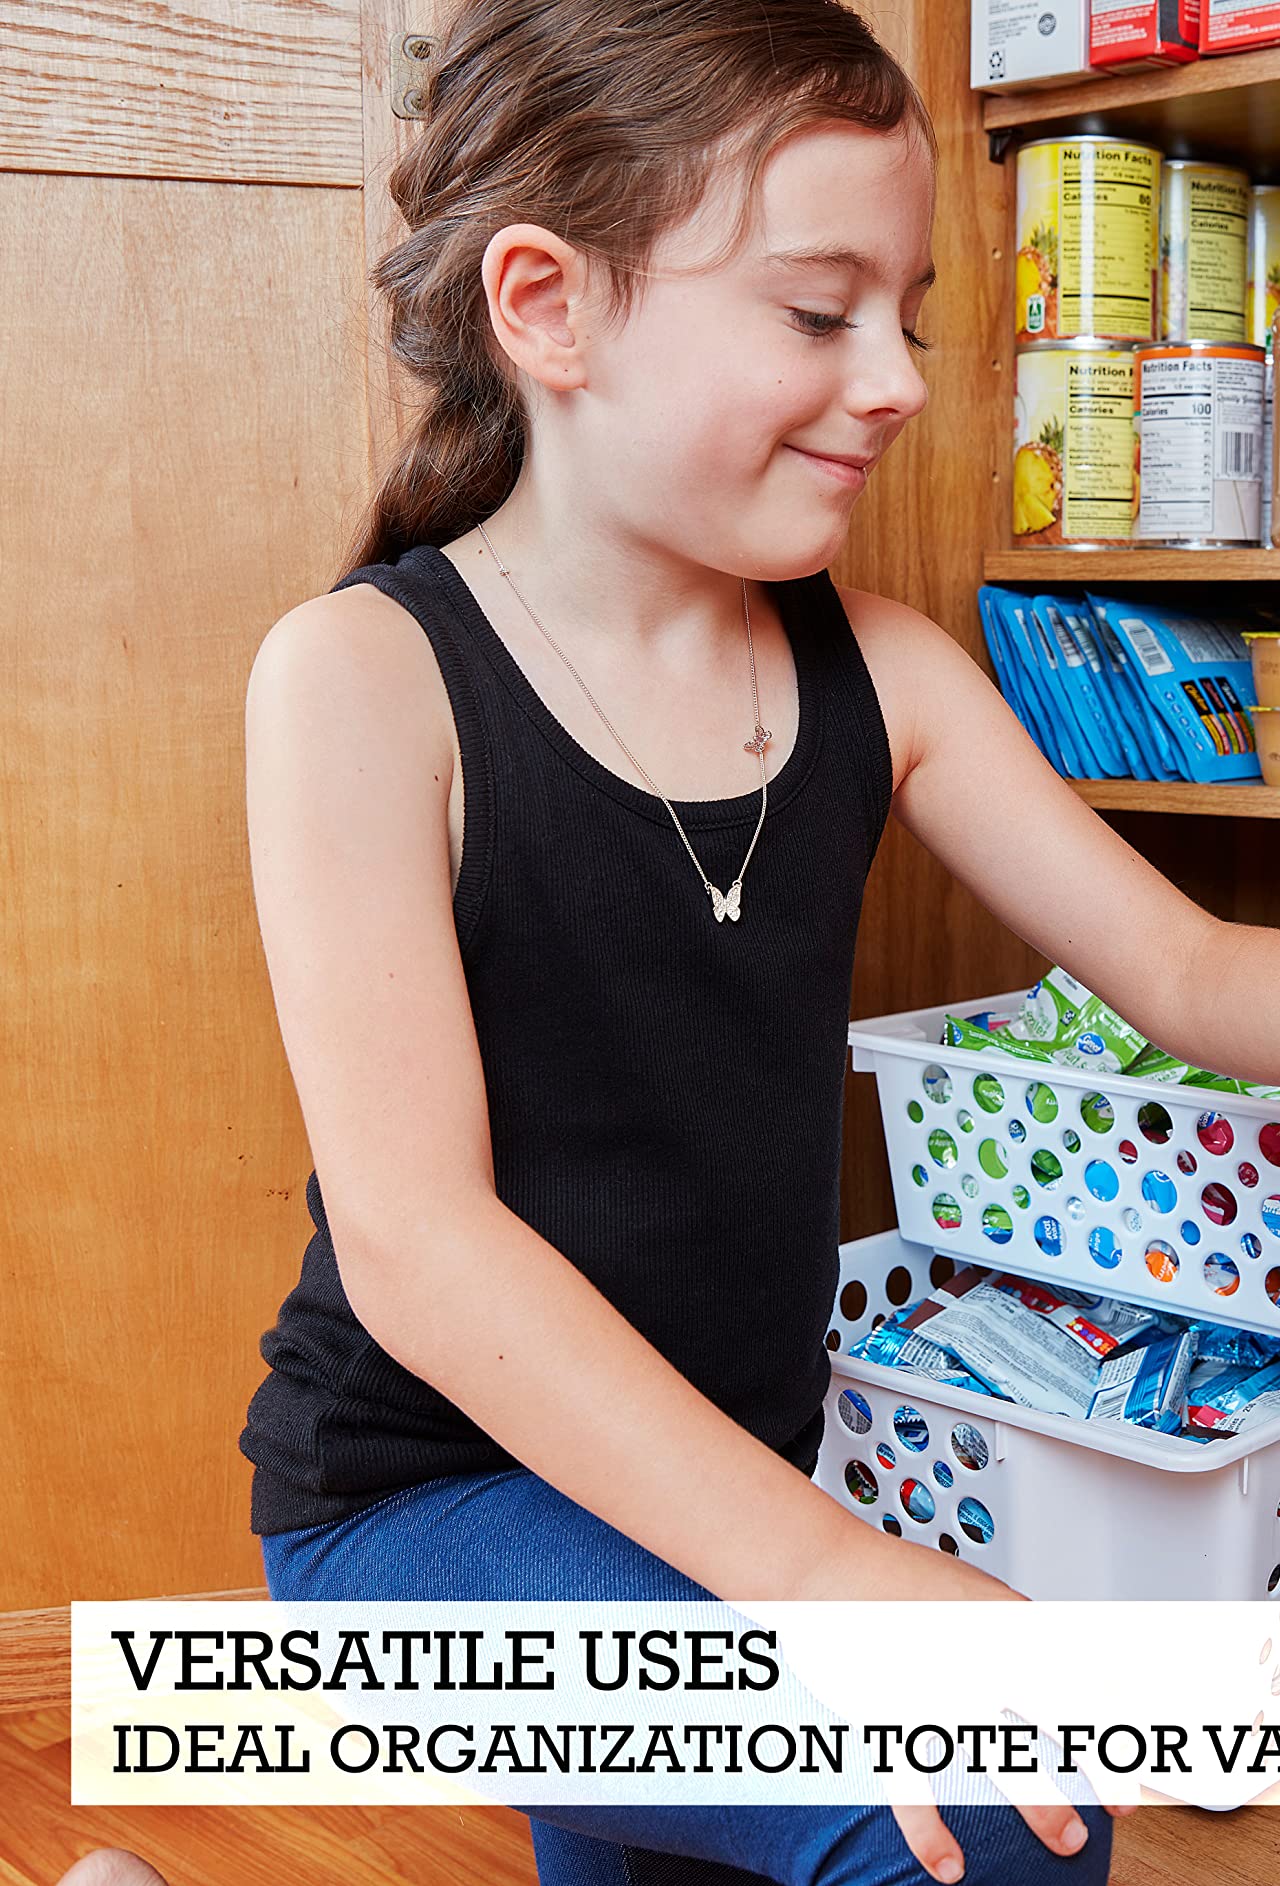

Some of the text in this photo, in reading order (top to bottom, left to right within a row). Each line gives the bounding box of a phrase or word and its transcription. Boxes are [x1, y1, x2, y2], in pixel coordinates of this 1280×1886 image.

[1124, 151, 1152, 165] Facts
[1069, 366, 1126, 377] Nutrition
[1143, 361, 1212, 373] Nutrition Facts
[1069, 406, 1114, 415] Calories
[1192, 403, 1212, 415] 100
